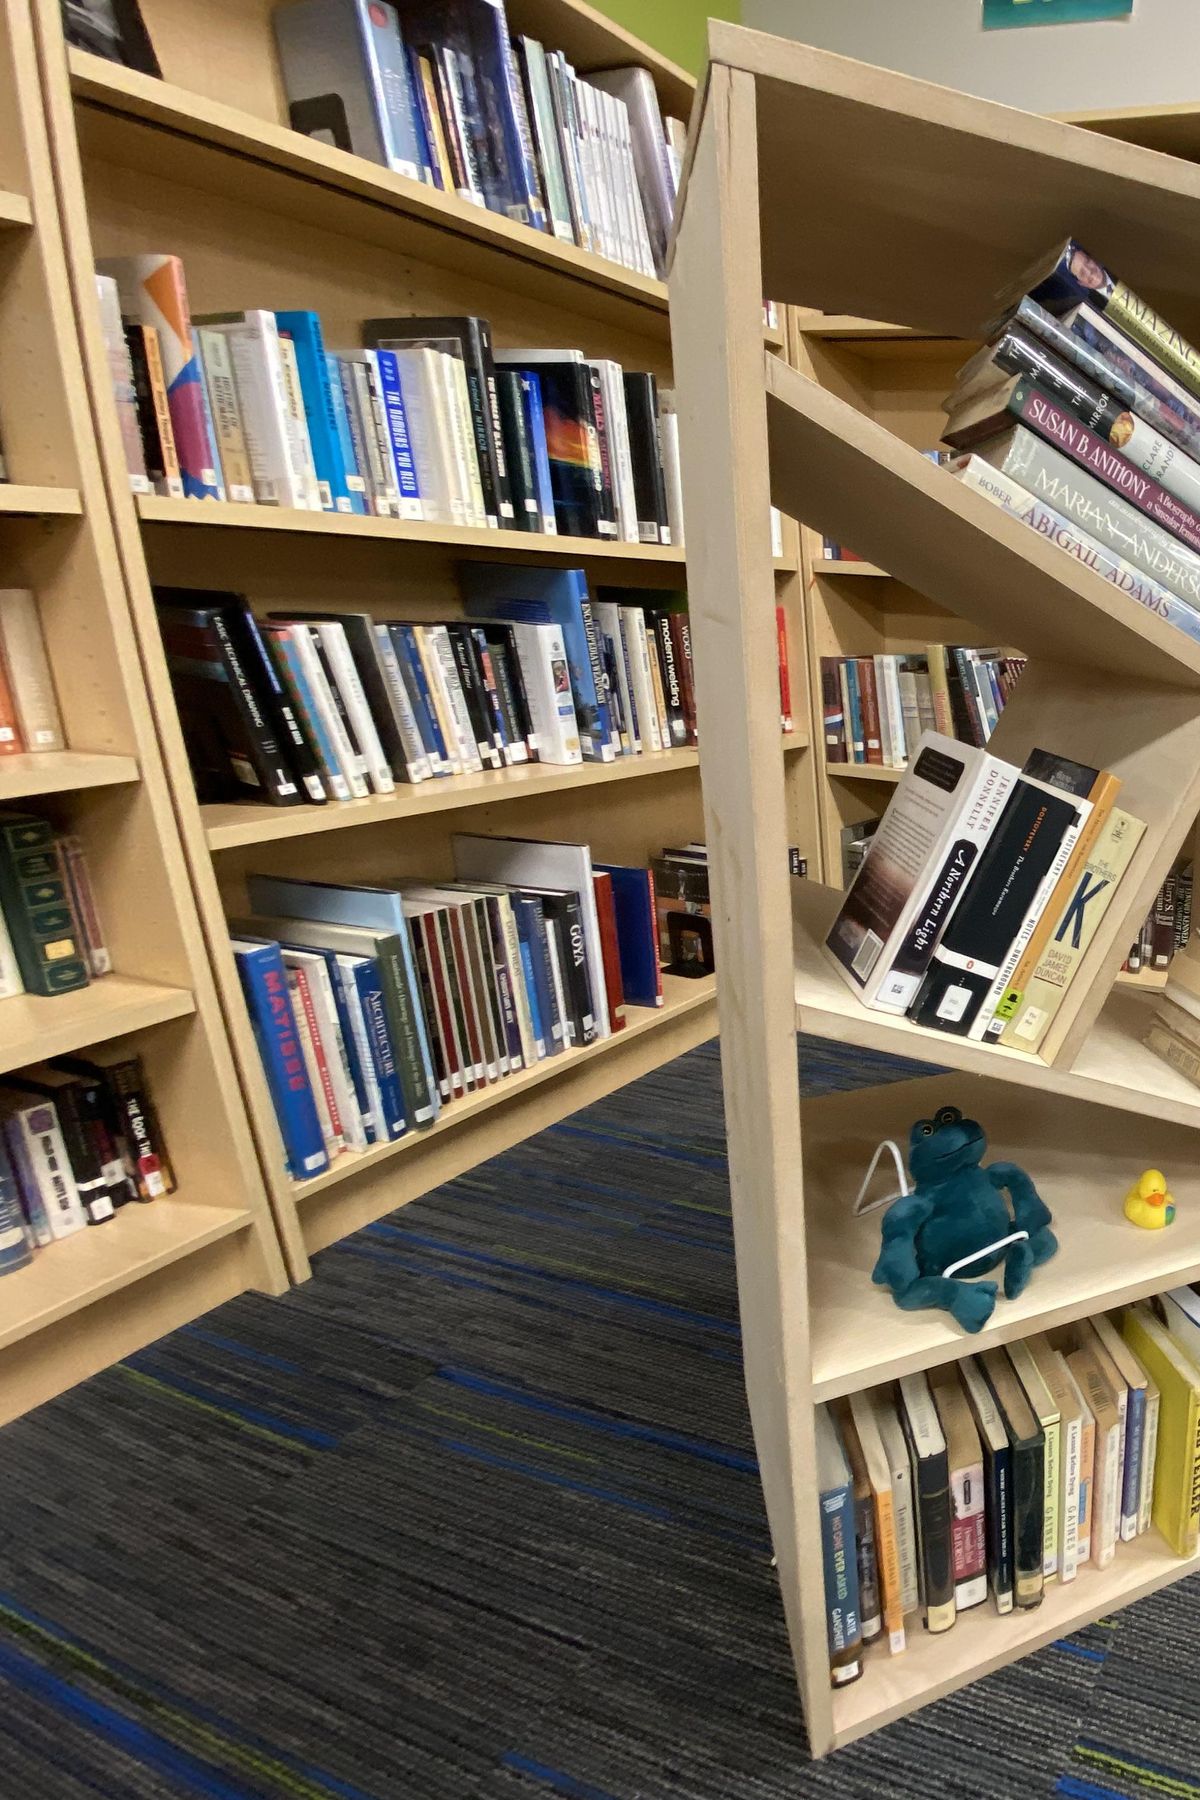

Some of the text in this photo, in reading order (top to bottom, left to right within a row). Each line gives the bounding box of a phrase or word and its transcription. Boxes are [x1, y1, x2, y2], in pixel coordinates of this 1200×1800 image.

[1120, 288, 1197, 367] AMAZING
[473, 414, 486, 452] MIRROR
[591, 393, 605, 433] MARS
[385, 391, 417, 492] THE NUMBERS YOU NEED
[1028, 398, 1152, 500] SUSAN B. ANTHONY
[1143, 439, 1163, 473] CLARE
[977, 476, 1013, 507] BOBER
[1035, 468, 1120, 540] MARIAN
[1152, 501, 1181, 532] Singular
[1163, 495, 1198, 530] Biography
[1020, 507, 1171, 619] ABIGAIL ADAMS
[581, 603, 598, 660] ENCYCLOPEDIA
[681, 625, 693, 660] WOOD
[213, 615, 265, 729] BASIC TECHNICAL DRAWING
[456, 641, 469, 665] Mental
[660, 618, 682, 708] modern welding
[965, 769, 999, 831] DONNELLY
[978, 774, 1012, 833] JENNIFER
[1004, 862, 1021, 889] Brothers
[1016, 854, 1026, 866] The
[1051, 834, 1077, 877] DOSTOEVSKY
[1082, 861, 1118, 883] BROTHERS
[914, 849, 966, 952] A Northern Light
[1054, 872, 1111, 951] K
[569, 924, 585, 968] GOYA
[1020, 918, 1037, 942] NOTES
[992, 948, 1021, 997] UNDERGROUND
[1034, 966, 1068, 986] DUNCAN
[1041, 958, 1069, 975] JAMES
[1047, 949, 1073, 967] DAVID
[262, 970, 307, 1093] MATISSE
[368, 990, 396, 1079] ARCHITECTURE
[127, 1098, 147, 1141] THE BOOK
[1045, 1481, 1053, 1499] Dying
[1046, 1460, 1054, 1480] Before
[1067, 1477, 1075, 1497] Dying
[1043, 1506, 1055, 1552] GAINES
[1065, 1505, 1077, 1552] GAINES
[835, 1550, 848, 1574] EVER
[836, 1572, 849, 1600] ASKED
[830, 1607, 846, 1650] GANSHERT
[846, 1610, 858, 1636] KATIE
